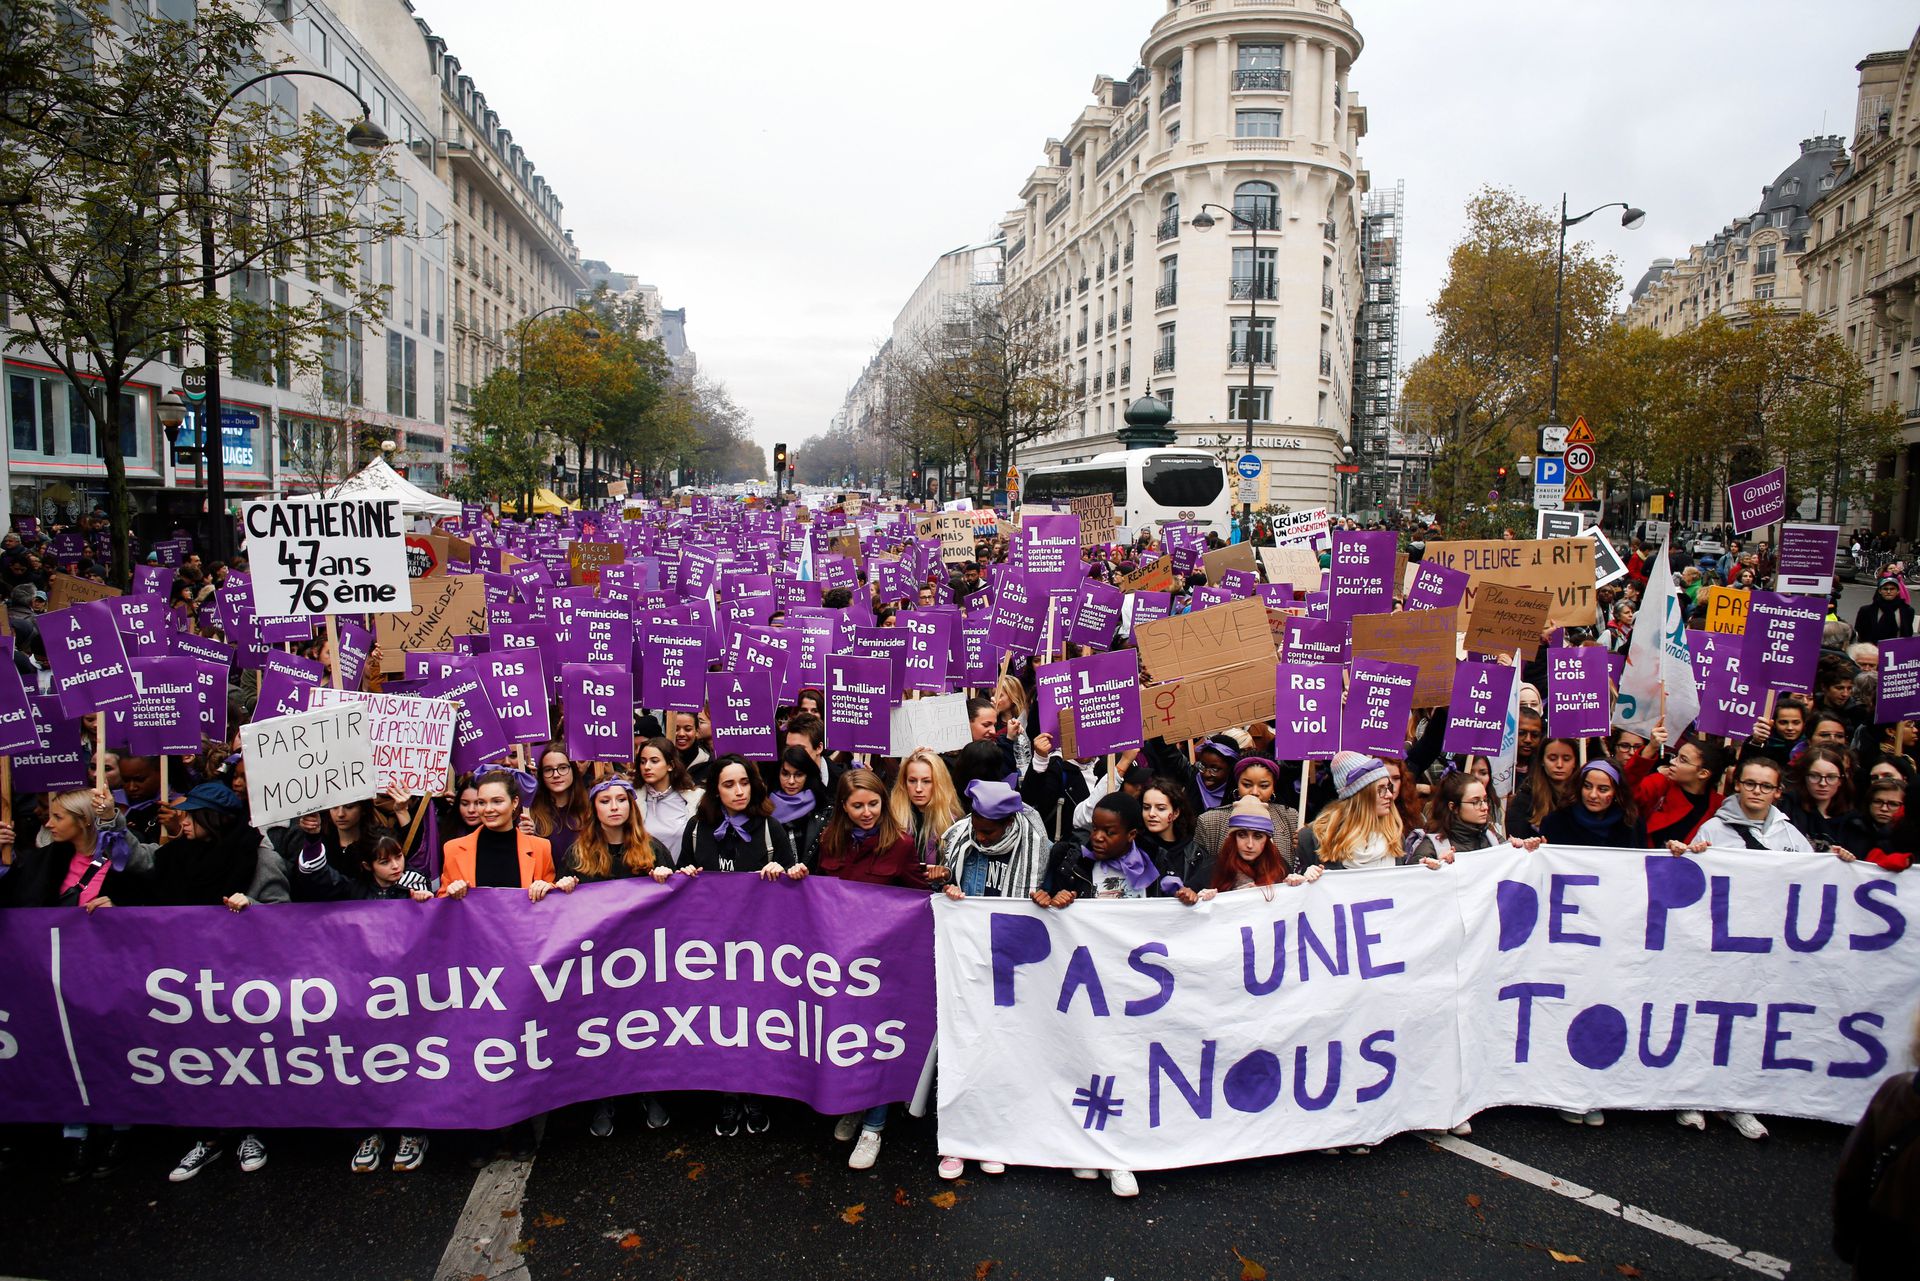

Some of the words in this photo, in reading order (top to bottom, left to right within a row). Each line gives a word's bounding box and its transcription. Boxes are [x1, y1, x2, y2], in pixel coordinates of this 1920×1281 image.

[185, 375, 206, 386] BUS
[1236, 437, 1301, 448] PRIBAS
[1569, 452, 1589, 465] 30
[1543, 462, 1558, 480] P
[1743, 479, 1781, 503] @nous
[1313, 509, 1327, 520] PAS
[936, 518, 949, 530] NE
[952, 517, 971, 529] TUE
[1028, 526, 1042, 546] 1
[1042, 536, 1076, 545] milliard
[1275, 529, 1287, 538] UN
[1028, 547, 1051, 555] contre
[1051, 547, 1063, 555] les
[1338, 541, 1351, 554] Je
[1353, 542, 1367, 553] te
[1028, 553, 1062, 561] violences
[1028, 559, 1057, 568] sexistes
[1057, 559, 1066, 567] et
[1338, 553, 1370, 565] crois
[1464, 548, 1521, 570] PLEURE
[1028, 565, 1062, 573] sexuelles
[1127, 559, 1160, 584] RESPECT
[1337, 576, 1351, 585] Tu
[1370, 577, 1382, 585] es
[1420, 570, 1432, 581] Je
[1432, 574, 1444, 585] te
[1004, 580, 1017, 592] Je
[1336, 587, 1362, 596] pour
[1363, 585, 1383, 595] rien
[1417, 581, 1444, 595] crois
[1002, 591, 1028, 604] crois
[575, 608, 629, 621] Féminicides
[998, 607, 1012, 619] Tu
[1024, 616, 1035, 625] es
[1494, 609, 1536, 625] MORTES
[1752, 603, 1821, 621] Féminicides
[70, 615, 81, 631] À
[589, 620, 611, 631] pas
[1147, 604, 1267, 652] SAVE
[1770, 618, 1796, 631] pas
[65, 634, 93, 650] bas
[589, 631, 611, 641] une
[648, 634, 702, 647] Féminicides
[1767, 630, 1795, 641] une
[593, 640, 609, 651] de
[663, 646, 683, 657] pas
[1771, 640, 1790, 652] de
[78, 651, 93, 665] le
[587, 651, 614, 662] plus
[662, 656, 684, 667] une
[1762, 652, 1795, 664] plus
[492, 661, 525, 677] Ras
[1554, 658, 1567, 671] Je
[1568, 658, 1583, 669] te
[60, 662, 124, 691] patriarcat
[666, 666, 681, 677] de
[1478, 670, 1489, 684] À
[1554, 669, 1586, 681] crois
[660, 677, 686, 688] plus
[732, 678, 743, 692] À
[832, 668, 847, 691] 1
[848, 684, 886, 695] milliard
[1078, 670, 1095, 695] 1
[1095, 676, 1135, 693] milliard
[1291, 674, 1326, 690] Ras
[1355, 670, 1412, 687] Féminicides
[501, 682, 519, 698] le
[582, 680, 615, 697] Ras
[1369, 686, 1391, 696] pas
[1470, 686, 1492, 700] bas
[726, 696, 751, 707] bas
[831, 694, 857, 703] contre
[858, 696, 870, 704] les
[1079, 695, 1106, 706] contre
[1107, 693, 1121, 702] les
[1299, 694, 1317, 712] le
[1366, 696, 1390, 708] une
[1555, 692, 1570, 701] Tu
[1587, 692, 1598, 700] es
[497, 700, 533, 719] viol
[590, 699, 607, 717] le
[831, 702, 869, 711] violences
[1079, 700, 1120, 713] violences
[1369, 706, 1385, 718] de
[1474, 701, 1486, 714] le
[1555, 703, 1581, 713] pour
[1582, 700, 1600, 710] rien
[735, 710, 749, 722] le
[831, 709, 863, 718] sexistes
[864, 711, 873, 719] et
[831, 715, 869, 726] sexuelles
[1080, 710, 1114, 721] sexistes
[1115, 707, 1125, 716] et
[1081, 716, 1121, 729] sexuelles
[1291, 716, 1327, 734] viol
[1361, 717, 1389, 730] plus
[1450, 716, 1502, 731] patriarcat
[583, 721, 618, 738] viol
[715, 724, 771, 738] patriarcat
[298, 750, 328, 769] OU
[1496, 874, 1601, 951] DE
[1644, 856, 1907, 953] PLUS
[990, 912, 1175, 1017] PAS
[1240, 898, 1405, 996] UNE
[144, 967, 338, 1036] Stop
[366, 966, 506, 1020] aux
[529, 928, 882, 1003] violences
[1498, 981, 1888, 1078] TOUTES
[126, 1032, 451, 1086] sexistes
[473, 1019, 553, 1083] et
[576, 1000, 907, 1067] sexuelles
